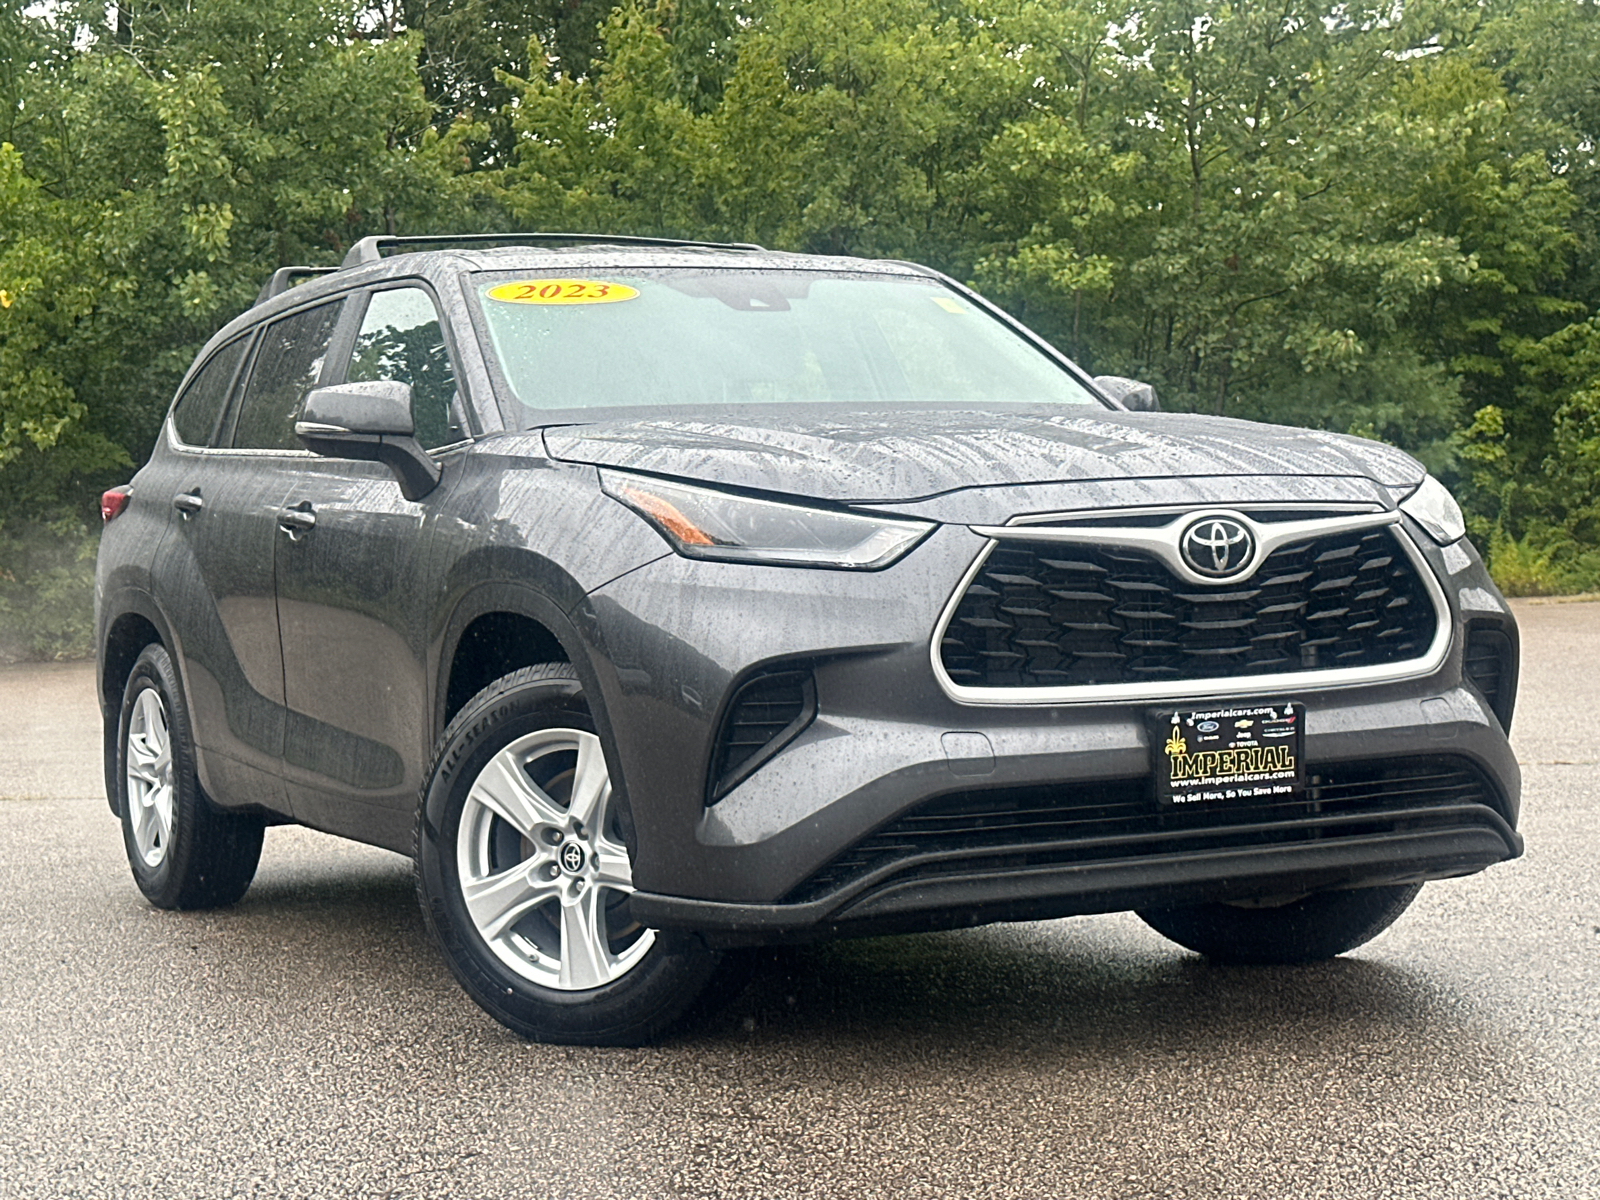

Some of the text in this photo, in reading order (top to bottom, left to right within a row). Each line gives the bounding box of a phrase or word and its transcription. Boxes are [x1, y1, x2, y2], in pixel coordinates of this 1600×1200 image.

[513, 284, 610, 300] 2023
[1191, 708, 1274, 720] Imperialcars.com
[440, 699, 521, 784] ALL-SEASON
[1236, 740, 1258, 748] TOYOTA
[1170, 745, 1295, 779] IMPERIAL
[1170, 771, 1295, 788] www.imperialcars.com
[1172, 785, 1292, 803] We Sell More, So You Save More
